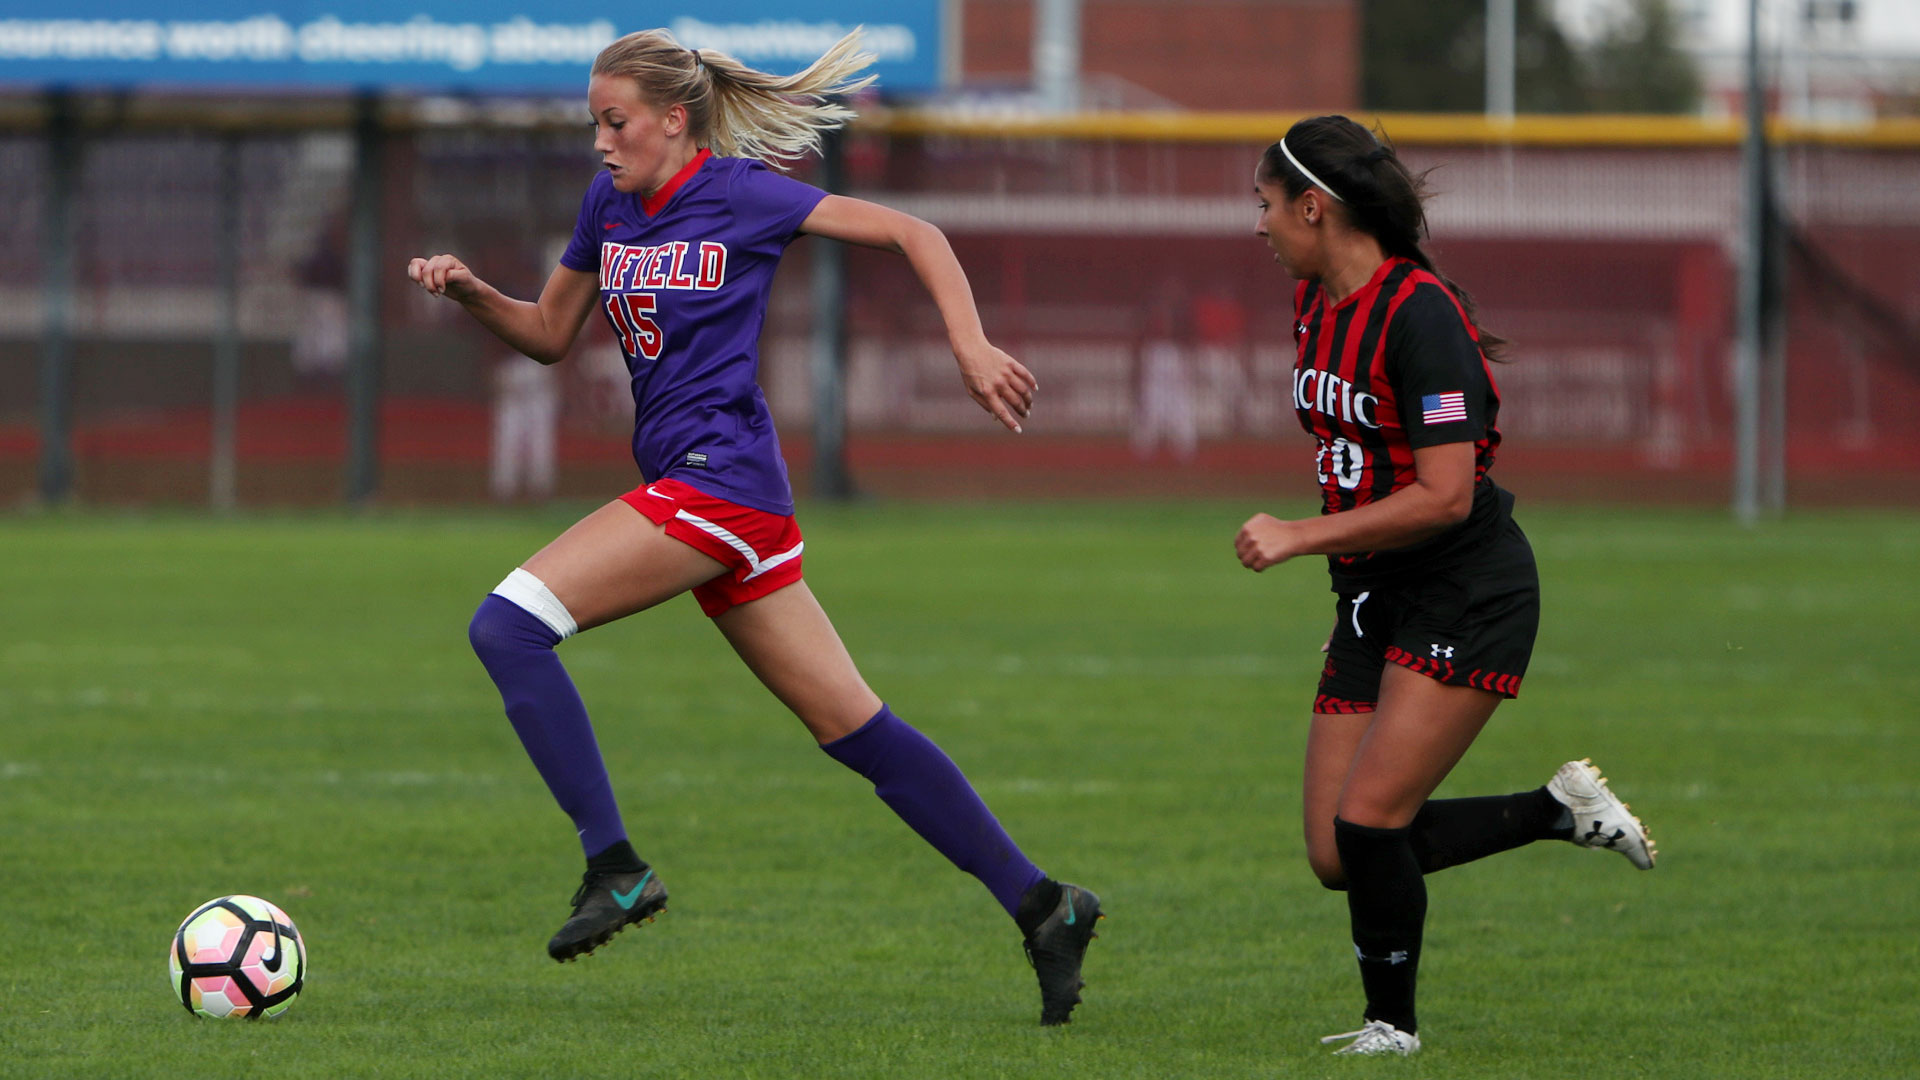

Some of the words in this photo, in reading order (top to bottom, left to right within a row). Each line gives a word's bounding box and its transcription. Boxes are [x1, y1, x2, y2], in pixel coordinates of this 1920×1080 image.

[167, 15, 291, 59] worth
[298, 15, 484, 71] cheering
[606, 293, 663, 360] 15
